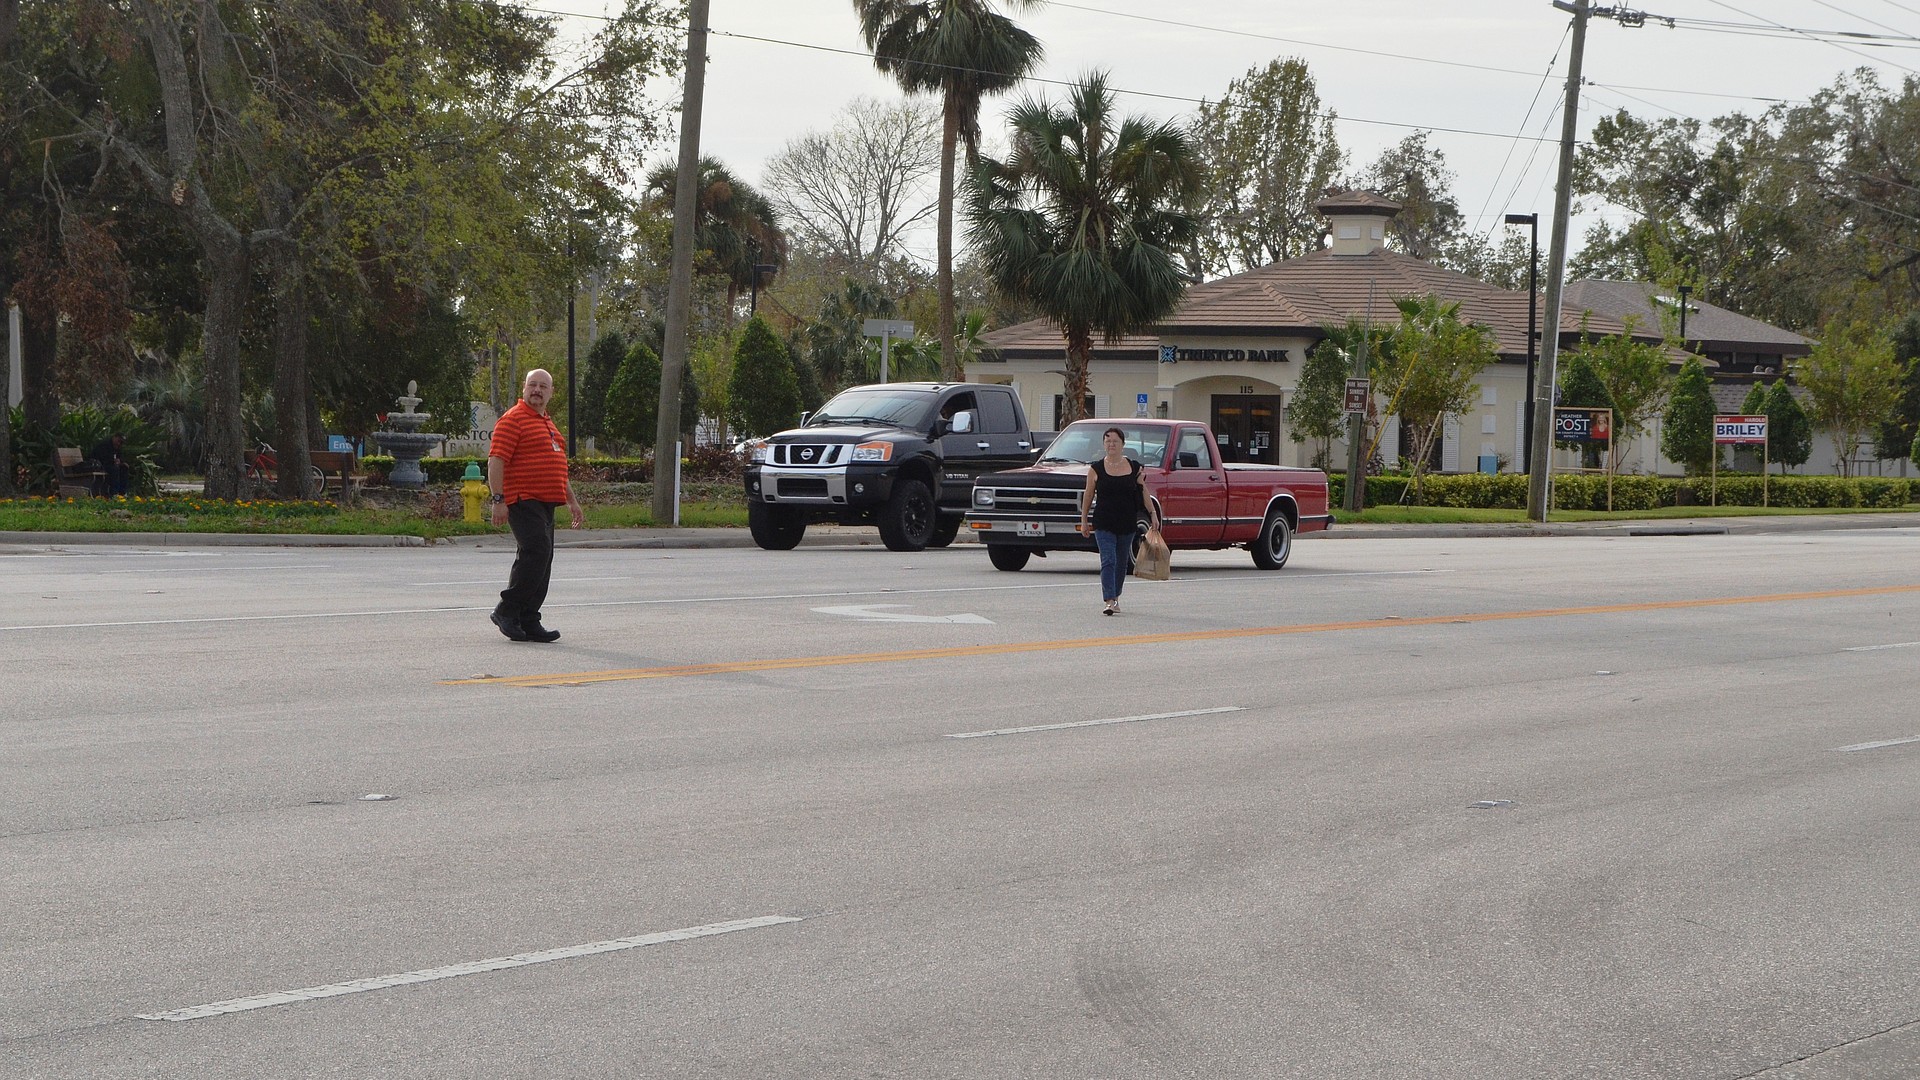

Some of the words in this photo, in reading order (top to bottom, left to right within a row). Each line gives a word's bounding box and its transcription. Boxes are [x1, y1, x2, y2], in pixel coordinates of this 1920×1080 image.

[1178, 348, 1245, 361] TRUSTCO
[1247, 350, 1290, 362] BANK
[1240, 386, 1253, 394] 115
[1556, 418, 1590, 431] POST
[1716, 425, 1765, 435] BRILEY
